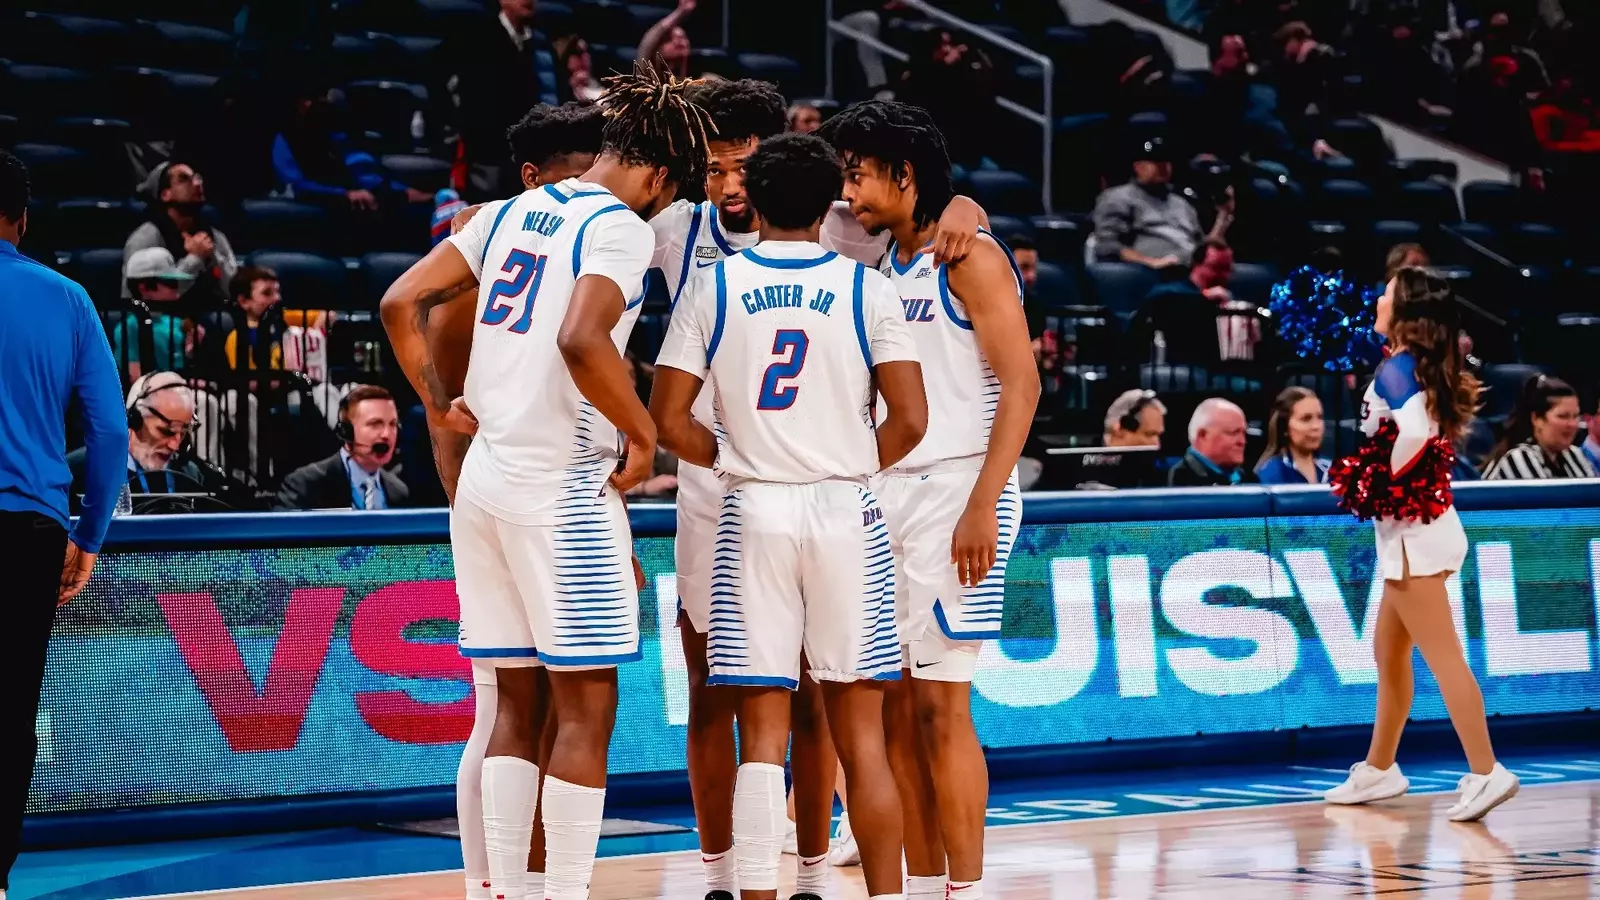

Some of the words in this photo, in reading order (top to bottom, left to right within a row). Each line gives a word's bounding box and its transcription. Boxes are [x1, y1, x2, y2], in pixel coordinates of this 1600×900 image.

[480, 248, 548, 334] 21
[741, 284, 804, 315] CARTER
[809, 288, 835, 317] JR.
[756, 329, 810, 411] 2
[156, 579, 477, 753] VS
